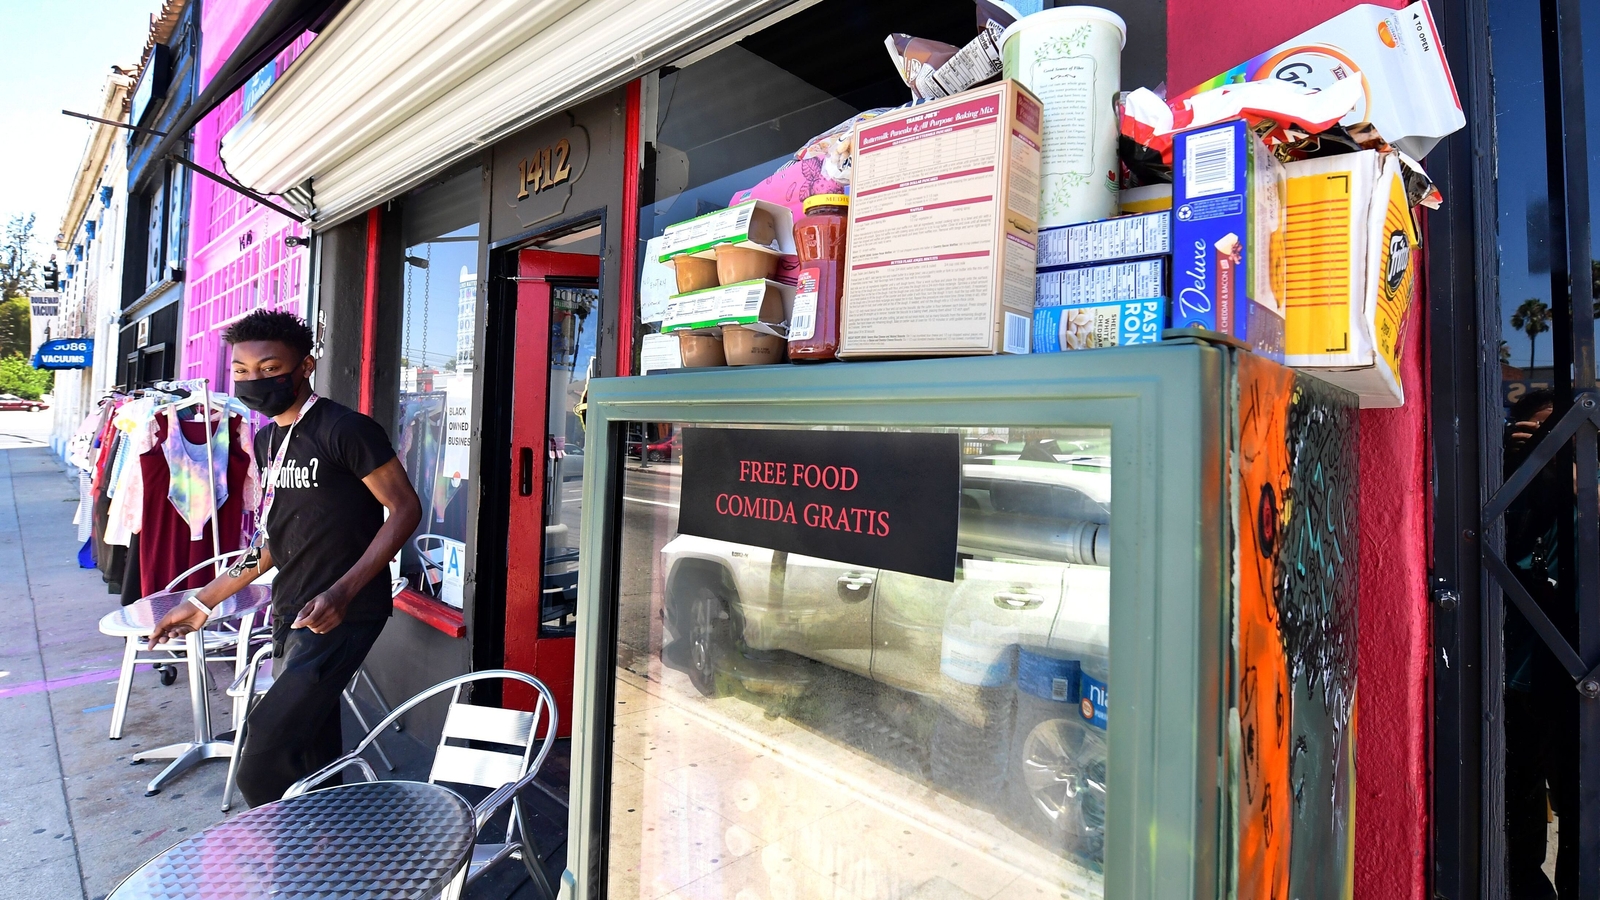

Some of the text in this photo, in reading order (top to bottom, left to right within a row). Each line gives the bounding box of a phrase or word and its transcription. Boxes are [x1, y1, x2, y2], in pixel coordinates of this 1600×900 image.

[1415, 21, 1429, 52] TO OPEN
[863, 132, 888, 145] Buttermilk
[890, 126, 912, 138] Pancake
[913, 124, 920, 132] &
[920, 120, 928, 130] All
[929, 116, 954, 128] Purpose
[955, 108, 979, 121] Baking
[979, 106, 994, 116] Mix
[906, 111, 938, 124] TRADER JOE'S
[517, 138, 571, 201] 1412
[1179, 238, 1212, 318] Deluxe
[31, 296, 59, 304] BOULEVARD
[32, 306, 59, 316] VACUUM
[1124, 302, 1141, 346] RON
[1142, 302, 1158, 343] PAST
[41, 354, 85, 363] VACUUMS
[448, 422, 469, 430] OWNED
[449, 407, 466, 416] BLACK
[448, 436, 471, 446] BUSINES
[739, 460, 859, 491] FREE FOOD
[715, 493, 890, 537] COMIDA GRATIS
[447, 547, 459, 577] A
